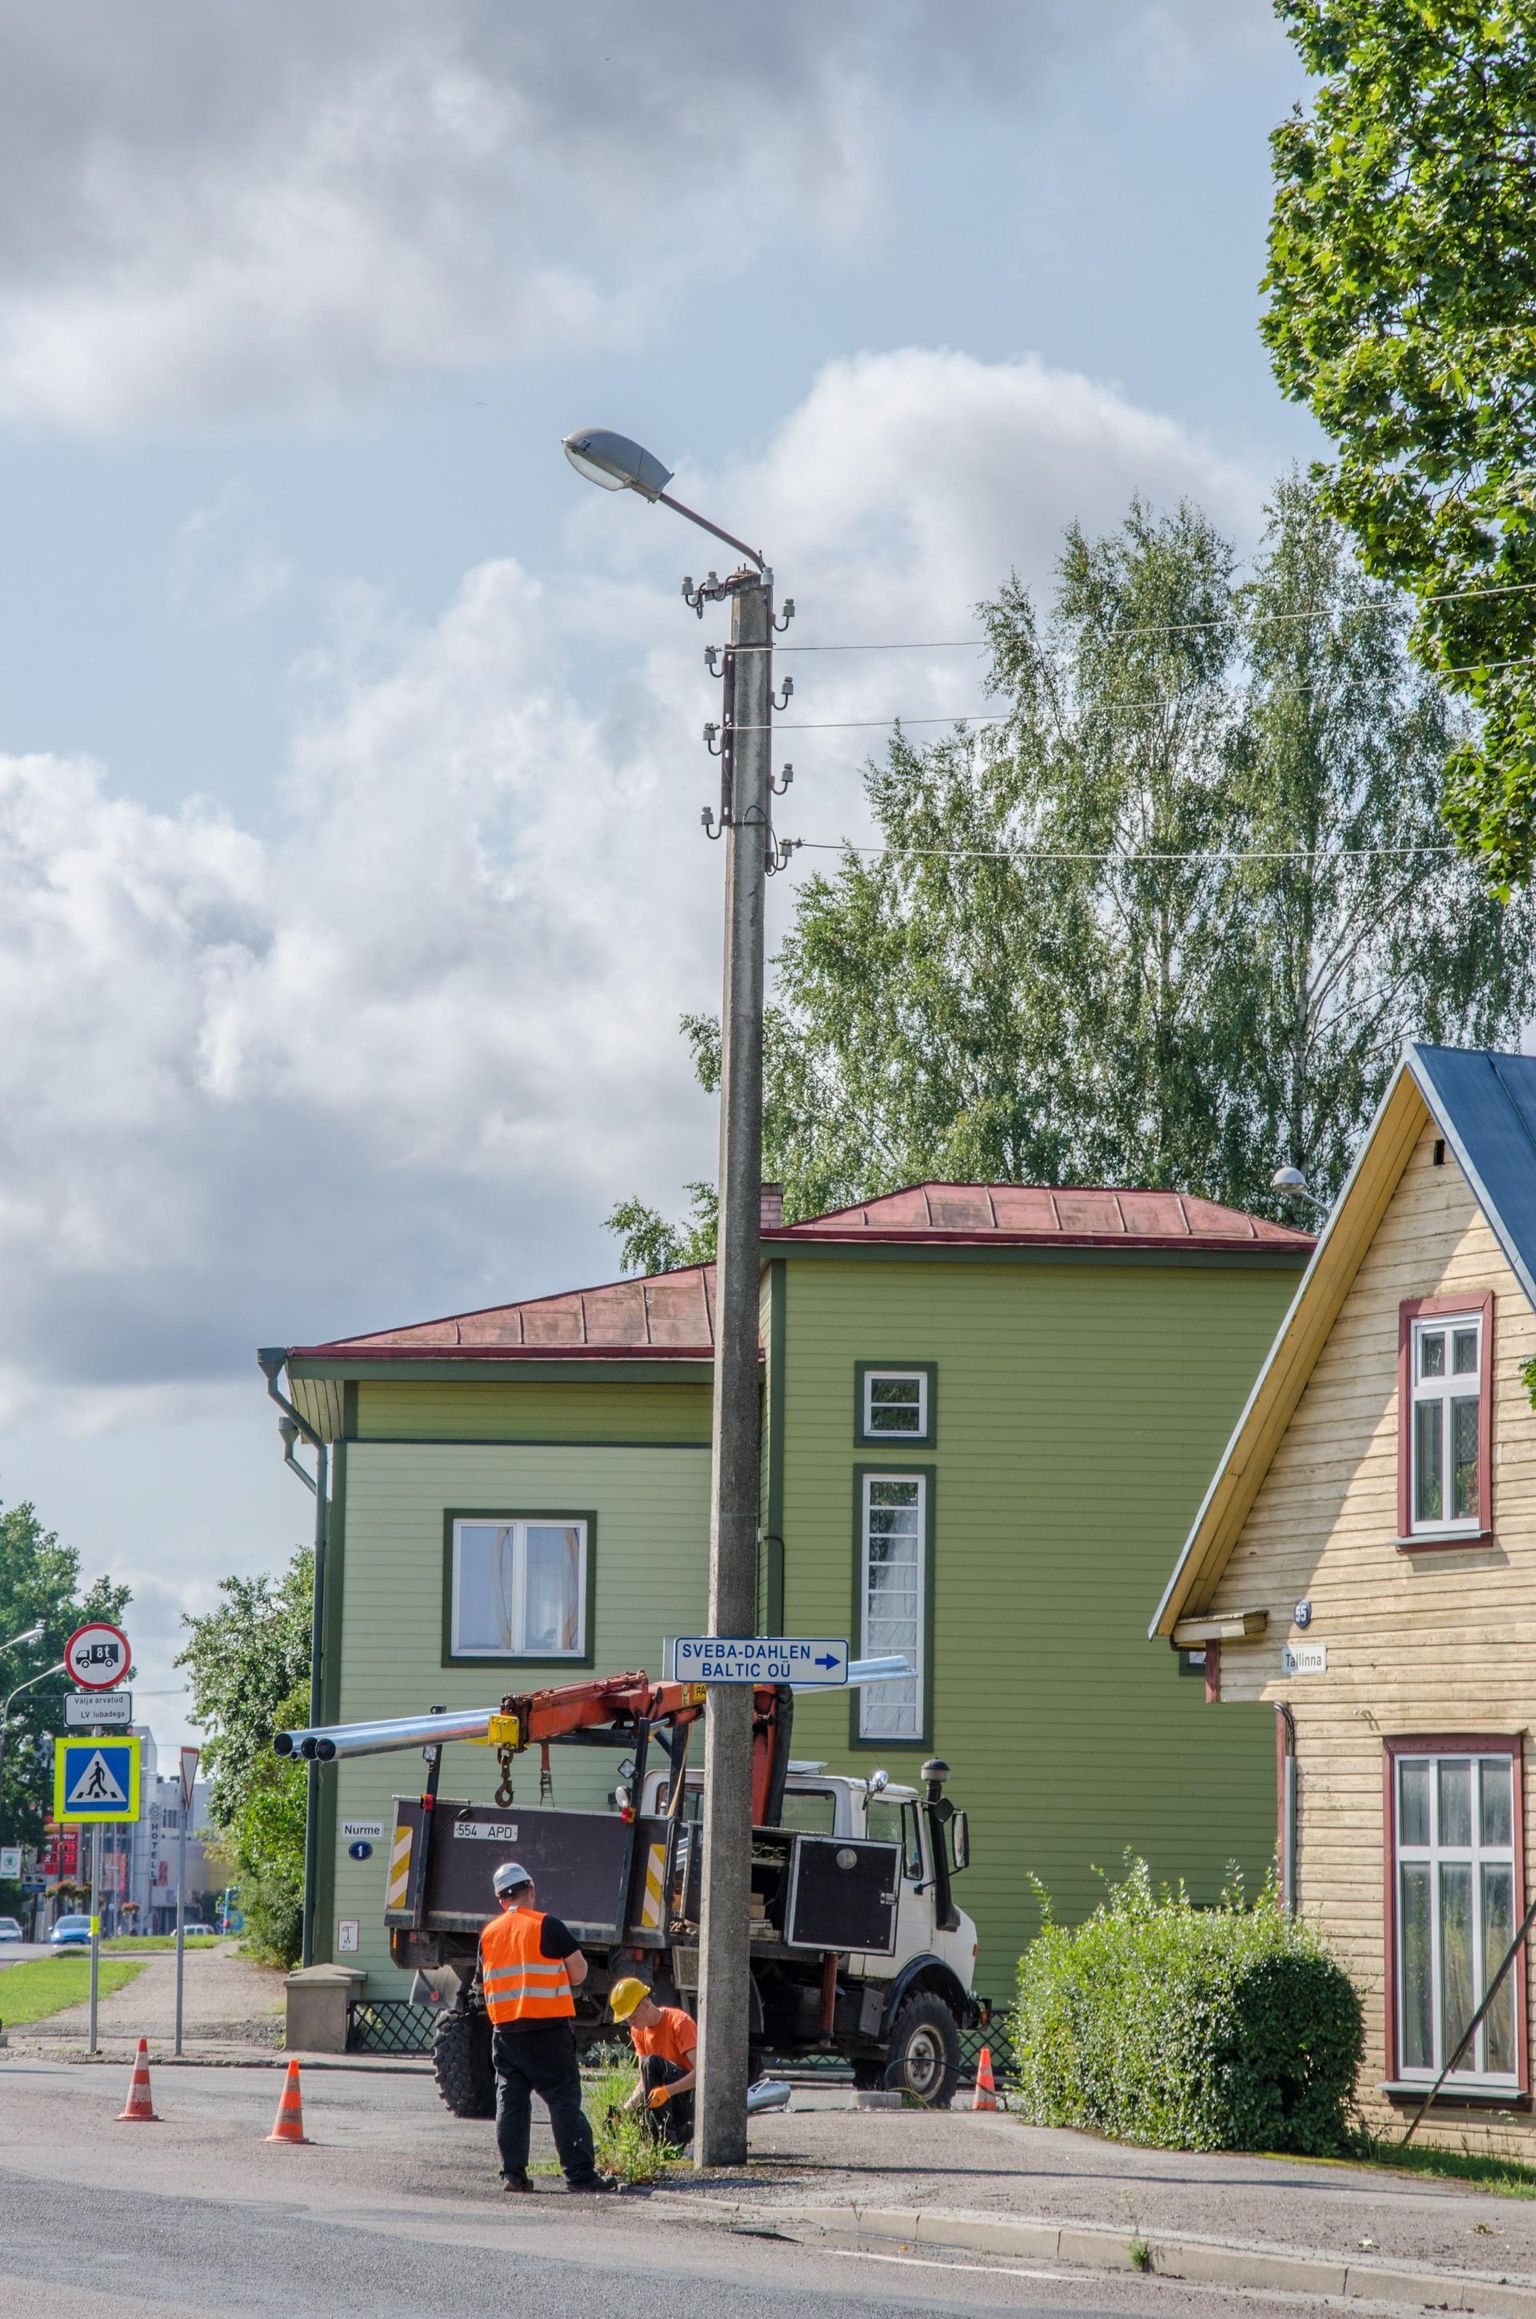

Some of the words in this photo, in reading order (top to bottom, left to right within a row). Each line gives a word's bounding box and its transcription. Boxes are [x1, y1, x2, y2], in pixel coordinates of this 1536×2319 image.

[1295, 1605, 1307, 1622] 55
[96, 1645, 110, 1659] 8t
[682, 1643, 811, 1659] SVEBA-DAHLEN
[1285, 1653, 1322, 1667] Tallinna
[702, 1662, 761, 1677] BALTIC
[767, 1660, 791, 1678] OÜ
[93, 1711, 125, 1719] lubadega
[344, 1825, 380, 1835] Nurme
[458, 1824, 477, 1837] 554
[488, 1826, 513, 1839] APD
[151, 1823, 159, 1878] HOTELL
[358, 1844, 363, 1857] 1
